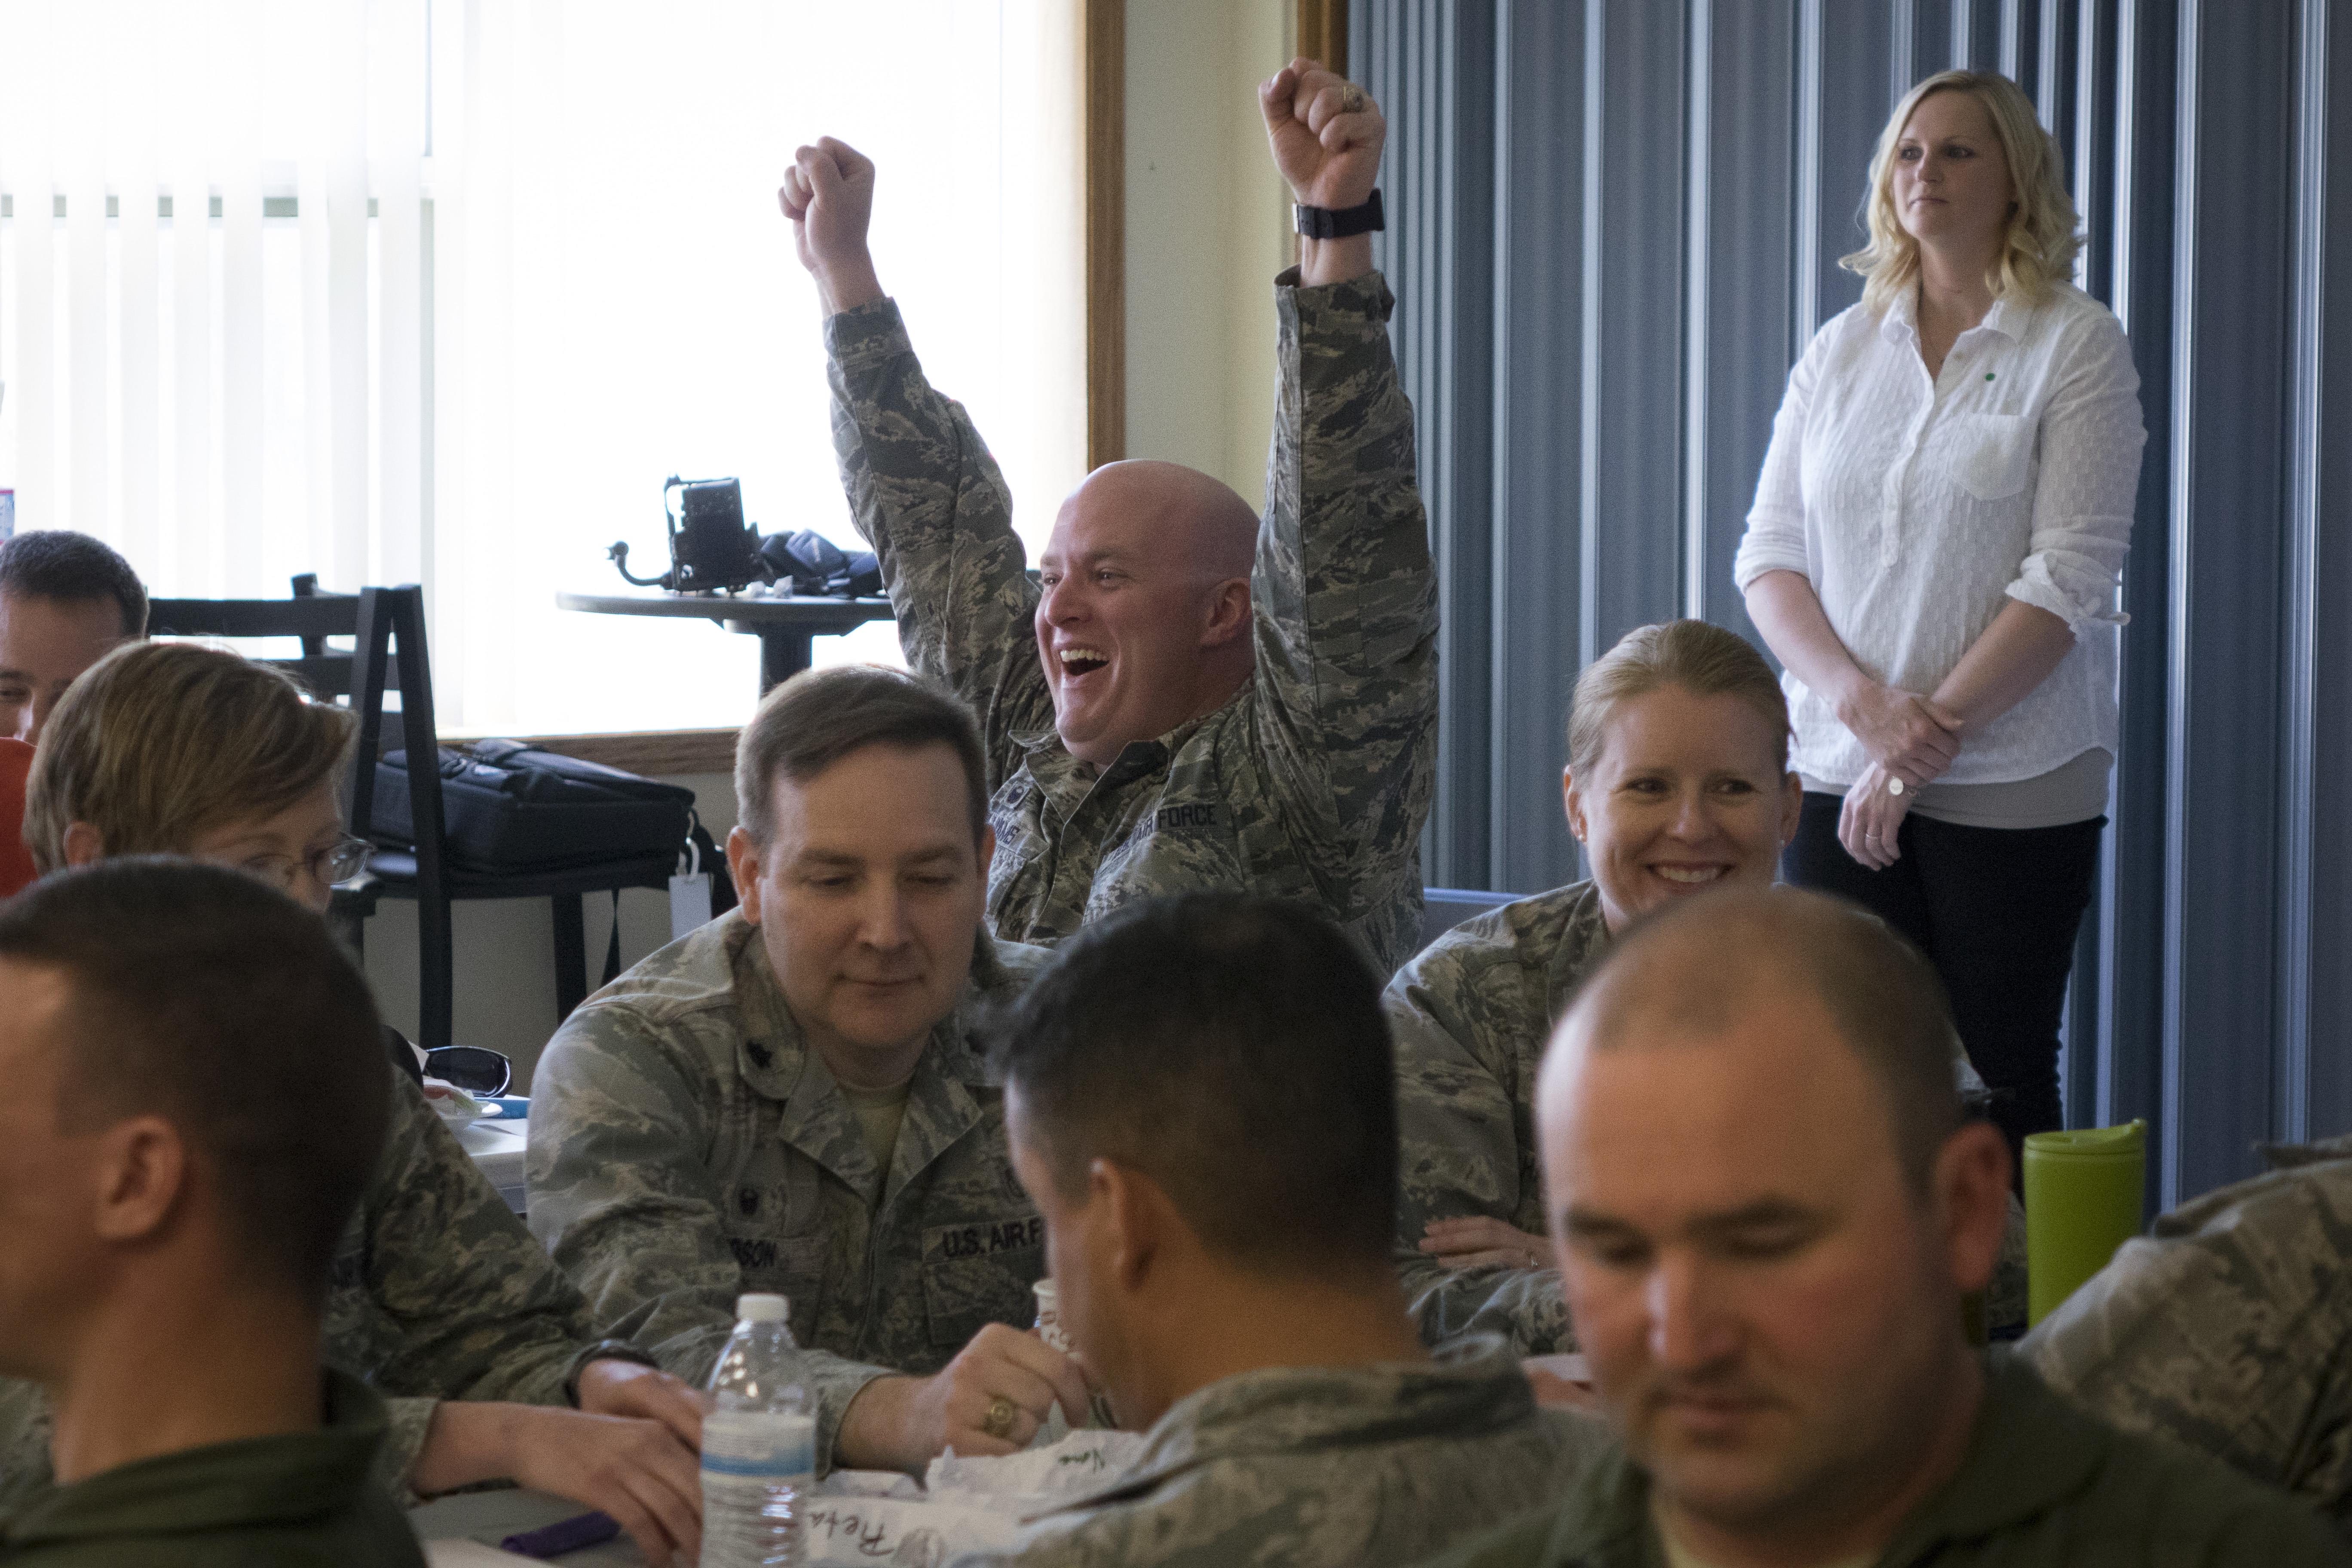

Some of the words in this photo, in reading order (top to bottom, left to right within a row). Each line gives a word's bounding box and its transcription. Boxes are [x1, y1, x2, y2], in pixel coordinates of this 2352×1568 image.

[1158, 803, 1217, 830] FORCE
[942, 1227, 986, 1258] U.S.
[989, 1220, 1027, 1252] AIR
